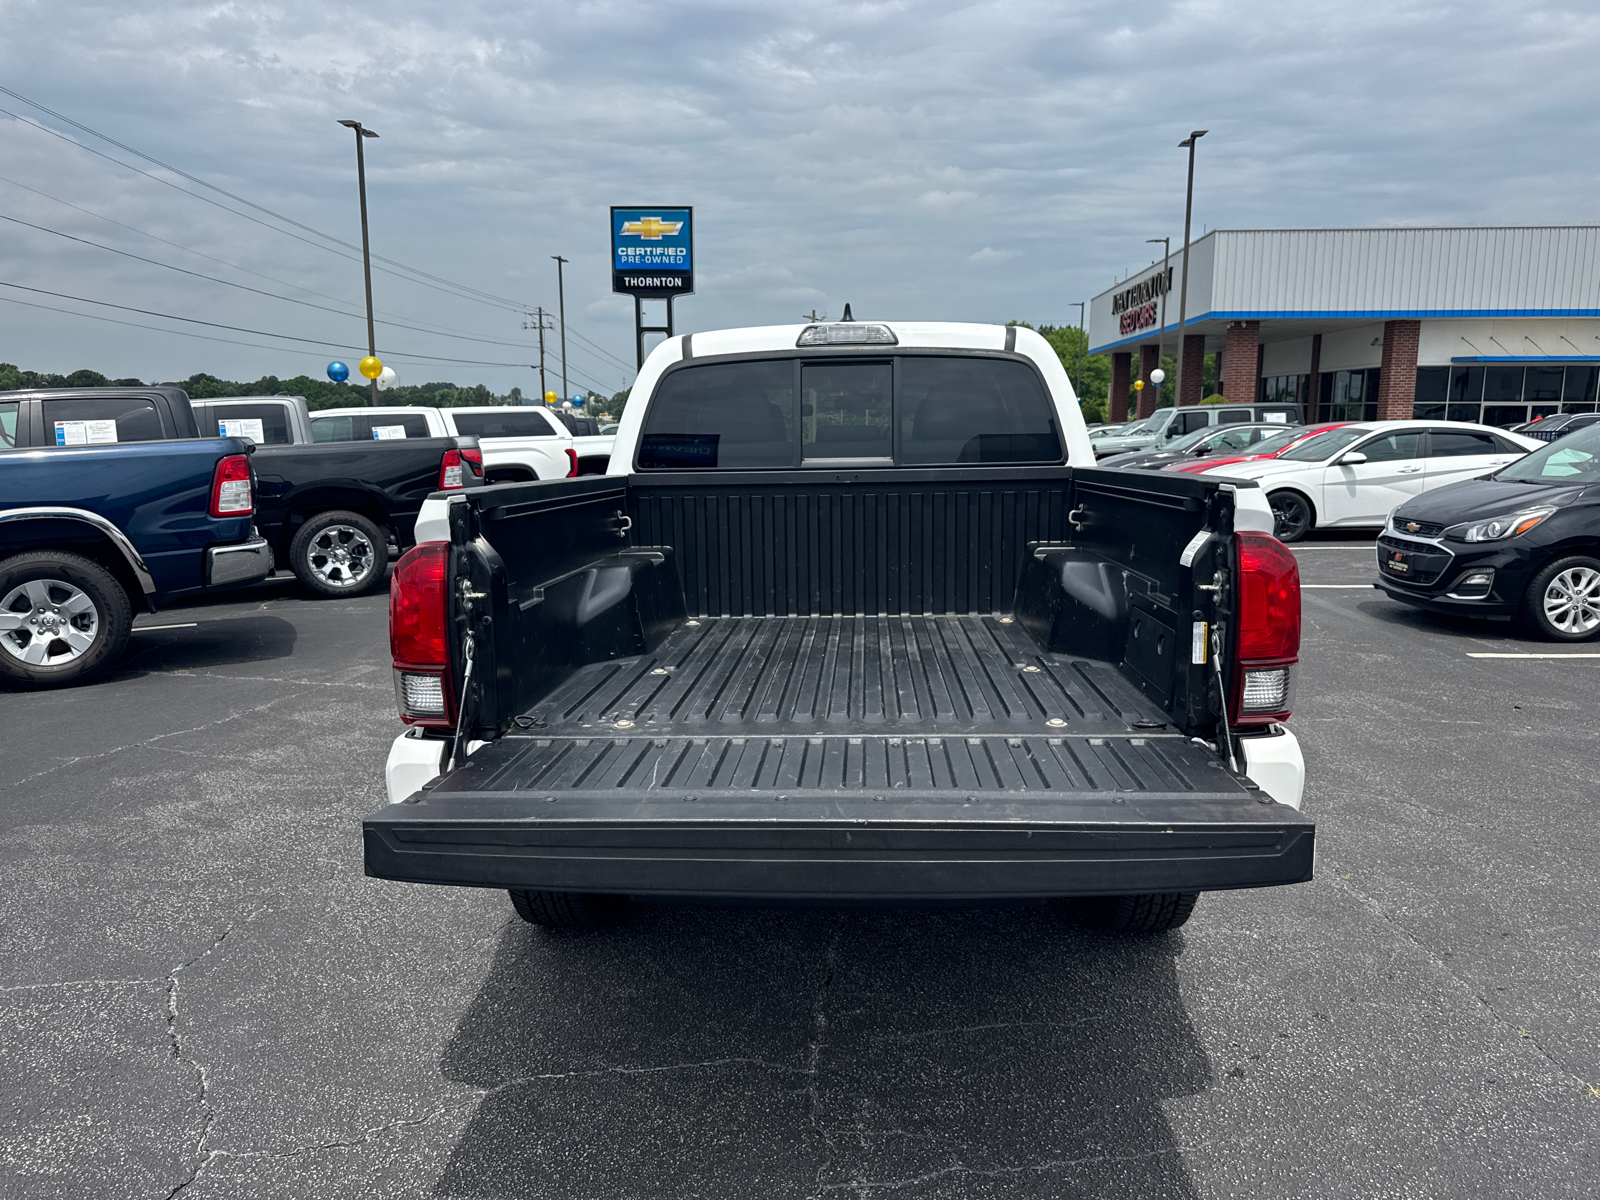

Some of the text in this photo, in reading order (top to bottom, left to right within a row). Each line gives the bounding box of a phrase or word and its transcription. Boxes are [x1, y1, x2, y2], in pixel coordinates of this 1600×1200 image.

[618, 247, 687, 256] CERTIFIED
[621, 256, 684, 264] PRE-OWNED
[624, 277, 682, 287] THORNTON
[1119, 302, 1157, 335] USED CARS
